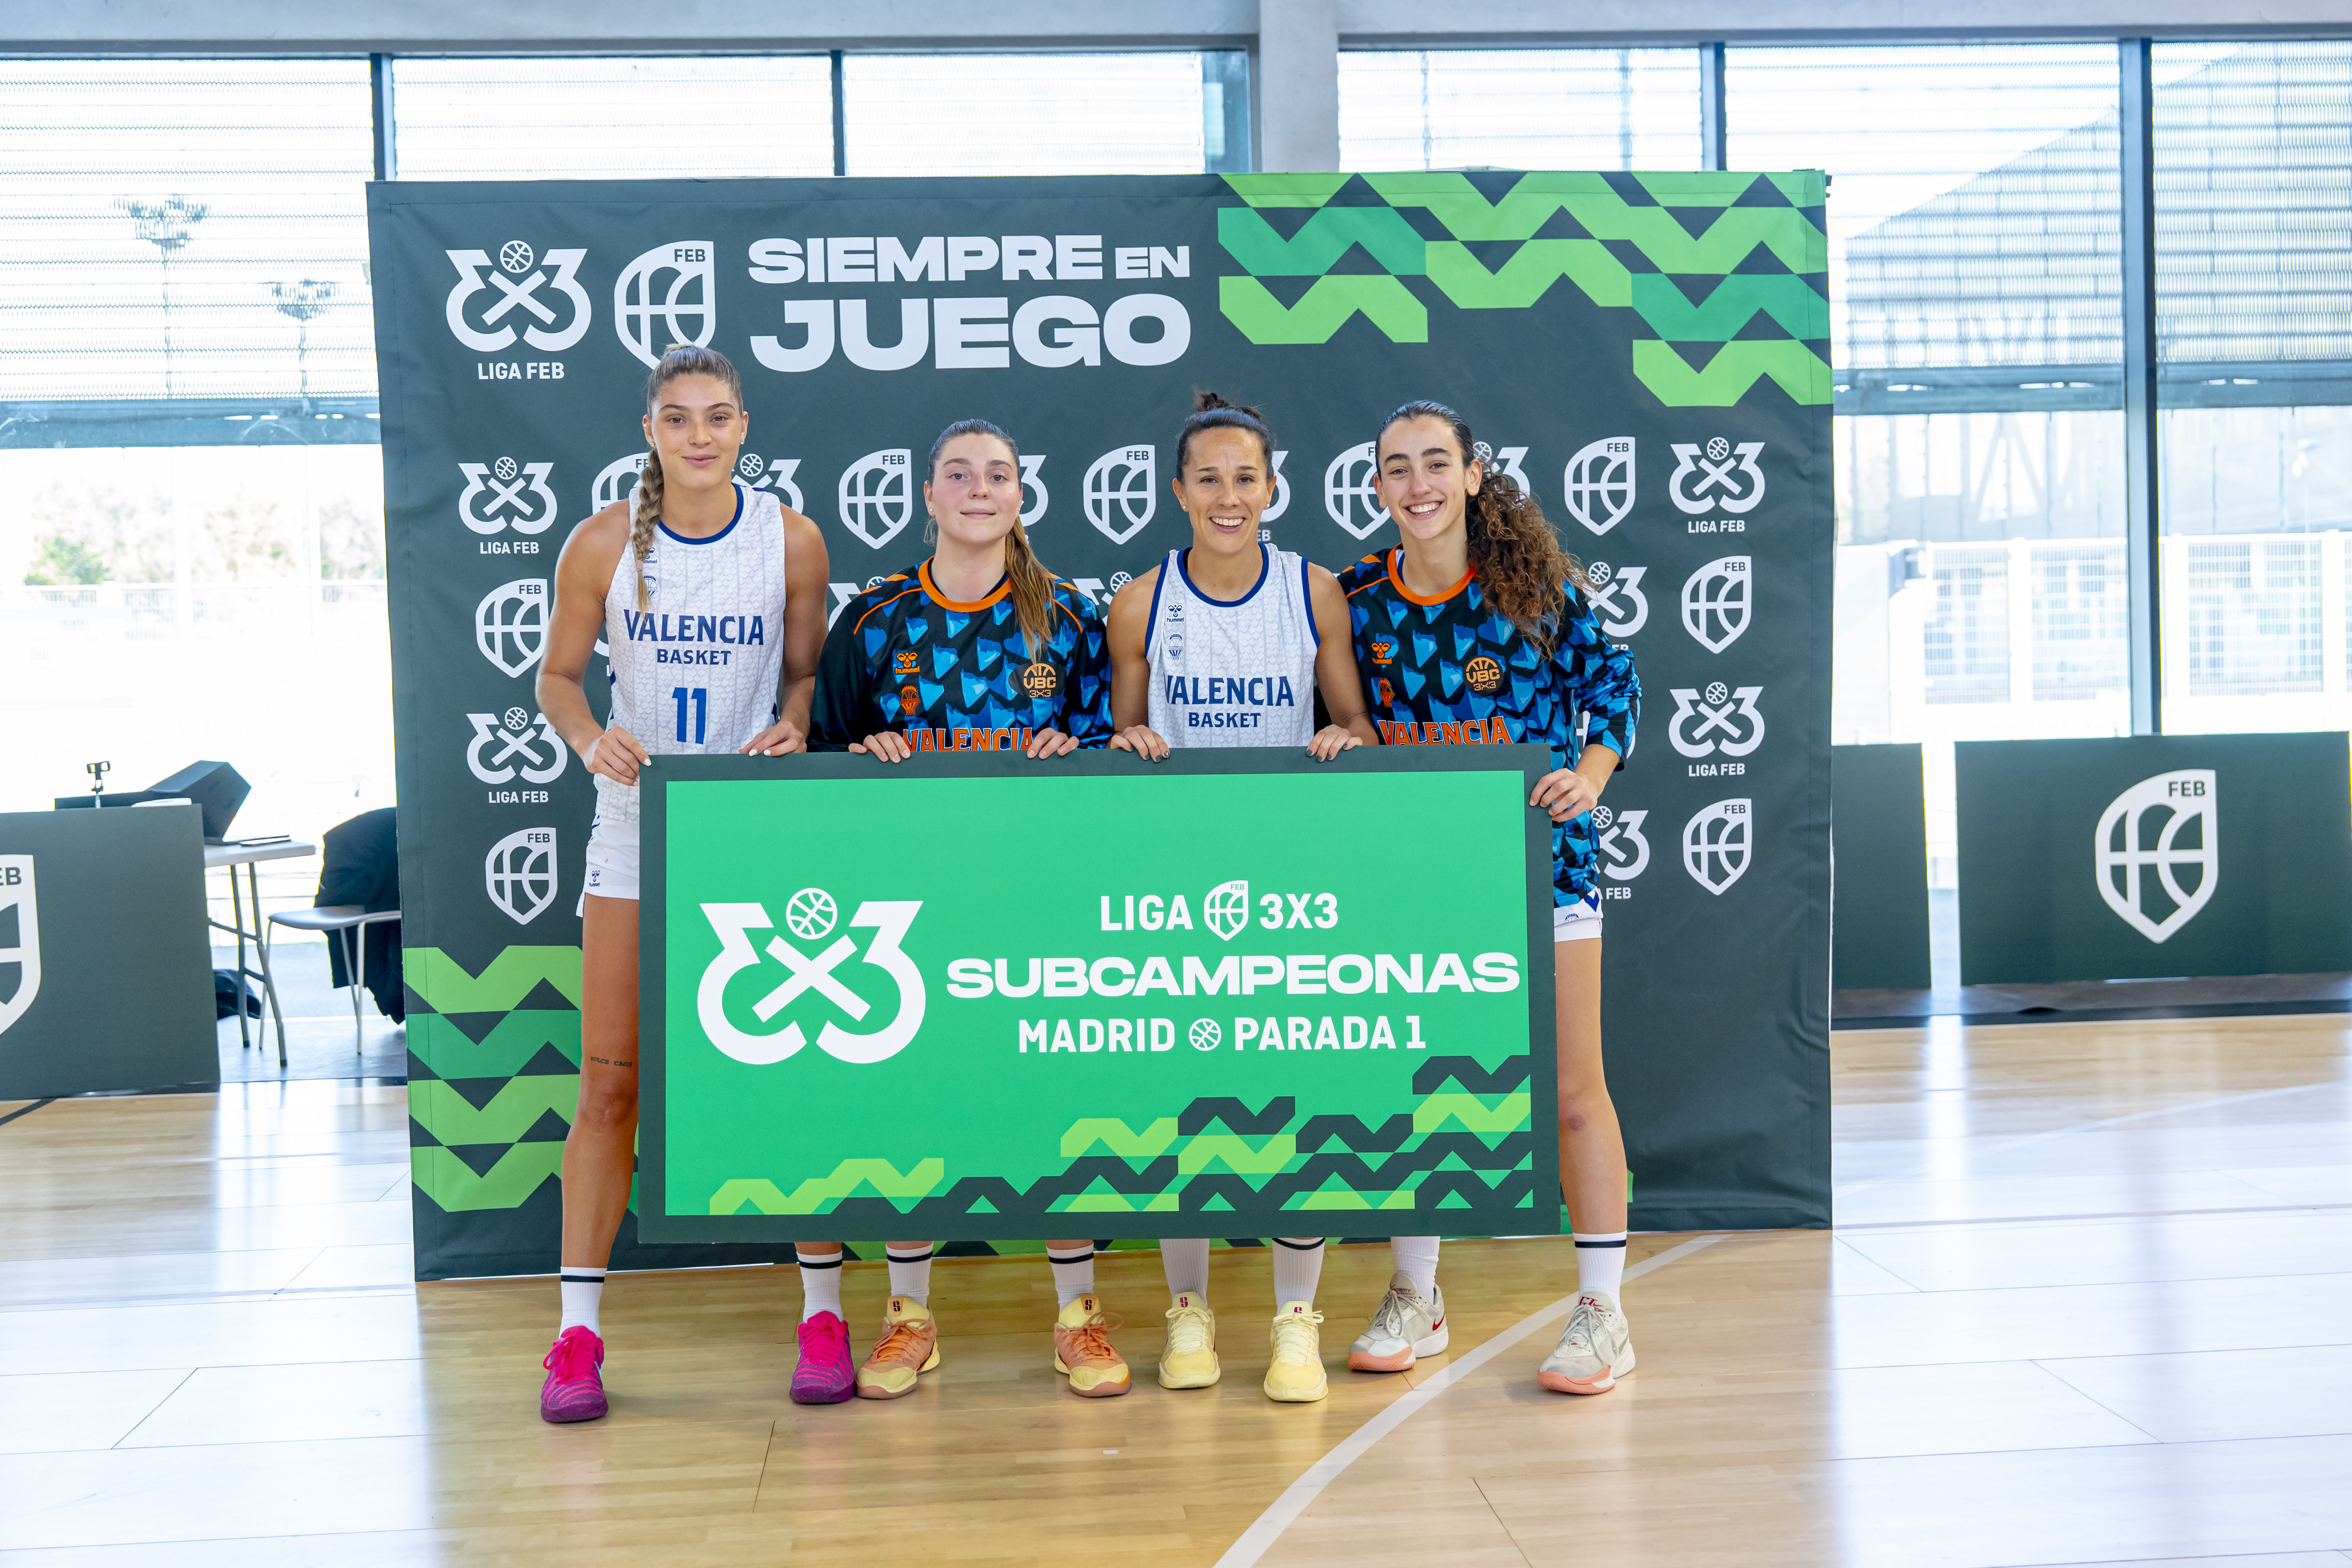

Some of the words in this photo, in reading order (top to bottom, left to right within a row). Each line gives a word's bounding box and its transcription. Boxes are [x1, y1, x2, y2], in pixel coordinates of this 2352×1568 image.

[675, 249, 706, 262] FEB
[749, 235, 1103, 284] SIEMPRE
[1115, 246, 1190, 279] EN
[750, 294, 1191, 373] JUEGO
[478, 363, 522, 380] LIGA
[527, 362, 564, 379] FEB
[1607, 443, 1629, 452] FEB
[883, 455, 905, 465] FEB
[1127, 451, 1149, 461] FEB
[636, 459, 649, 468] FE
[1688, 521, 1717, 533] LIGA
[1721, 520, 1745, 532] FEB
[480, 542, 511, 554] LIGA
[514, 542, 539, 554] FEB
[1725, 562, 1746, 572] FEB
[519, 585, 541, 594] FEB
[623, 609, 764, 646] VALENCIA
[657, 649, 732, 665] BASKET
[895, 666, 920, 674] hummel
[1466, 669, 1500, 683] VBC
[1023, 677, 1056, 689] VBC
[672, 687, 707, 744] 11
[1189, 712, 1261, 728] BASKET
[1377, 716, 1513, 745] VALENCIA
[1689, 764, 1718, 777] LIGA
[1721, 763, 1745, 775] FEB
[2169, 781, 2205, 797] FEB
[489, 792, 519, 803] LIGA
[523, 791, 549, 803] FEB
[1725, 805, 1746, 814] FEB
[528, 834, 550, 843] FEB
[1606, 887, 1631, 900] FEB
[1101, 895, 1194, 931] LIGA
[1260, 893, 1338, 929] 3X3
[947, 952, 1520, 998] SUBCAMPEONAS
[1019, 1019, 1175, 1053] MADRID
[1235, 1016, 1397, 1051] PARADA
[1407, 1016, 1426, 1049] 1
